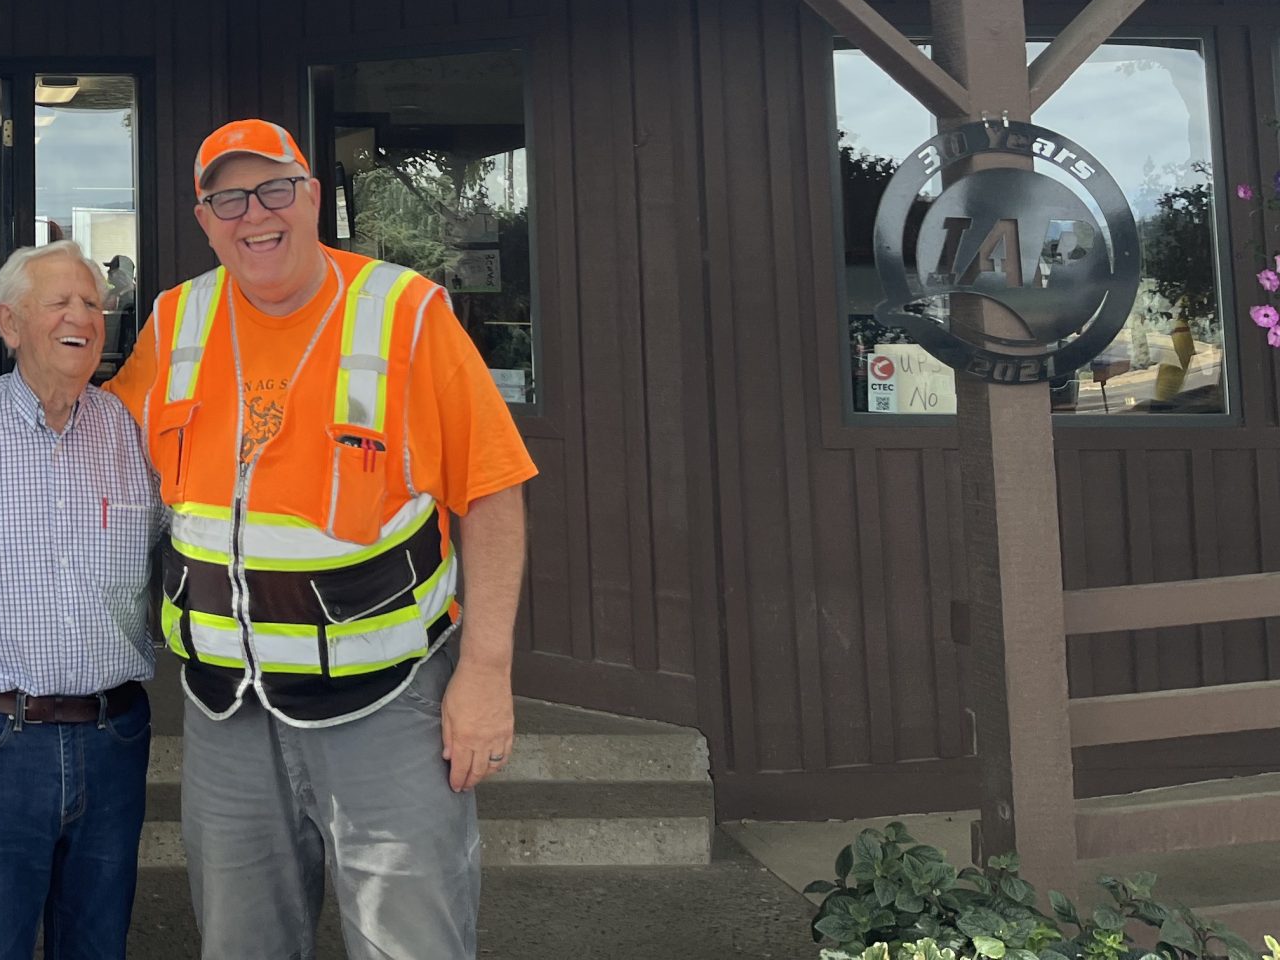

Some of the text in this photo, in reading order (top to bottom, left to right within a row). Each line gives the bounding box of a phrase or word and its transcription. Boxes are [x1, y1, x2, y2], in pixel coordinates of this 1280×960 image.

[917, 125, 1096, 180] 30 Years
[966, 355, 1057, 383] 2021
[255, 379, 274, 391] AG
[870, 383, 895, 392] CTEC
[909, 382, 939, 411] No
